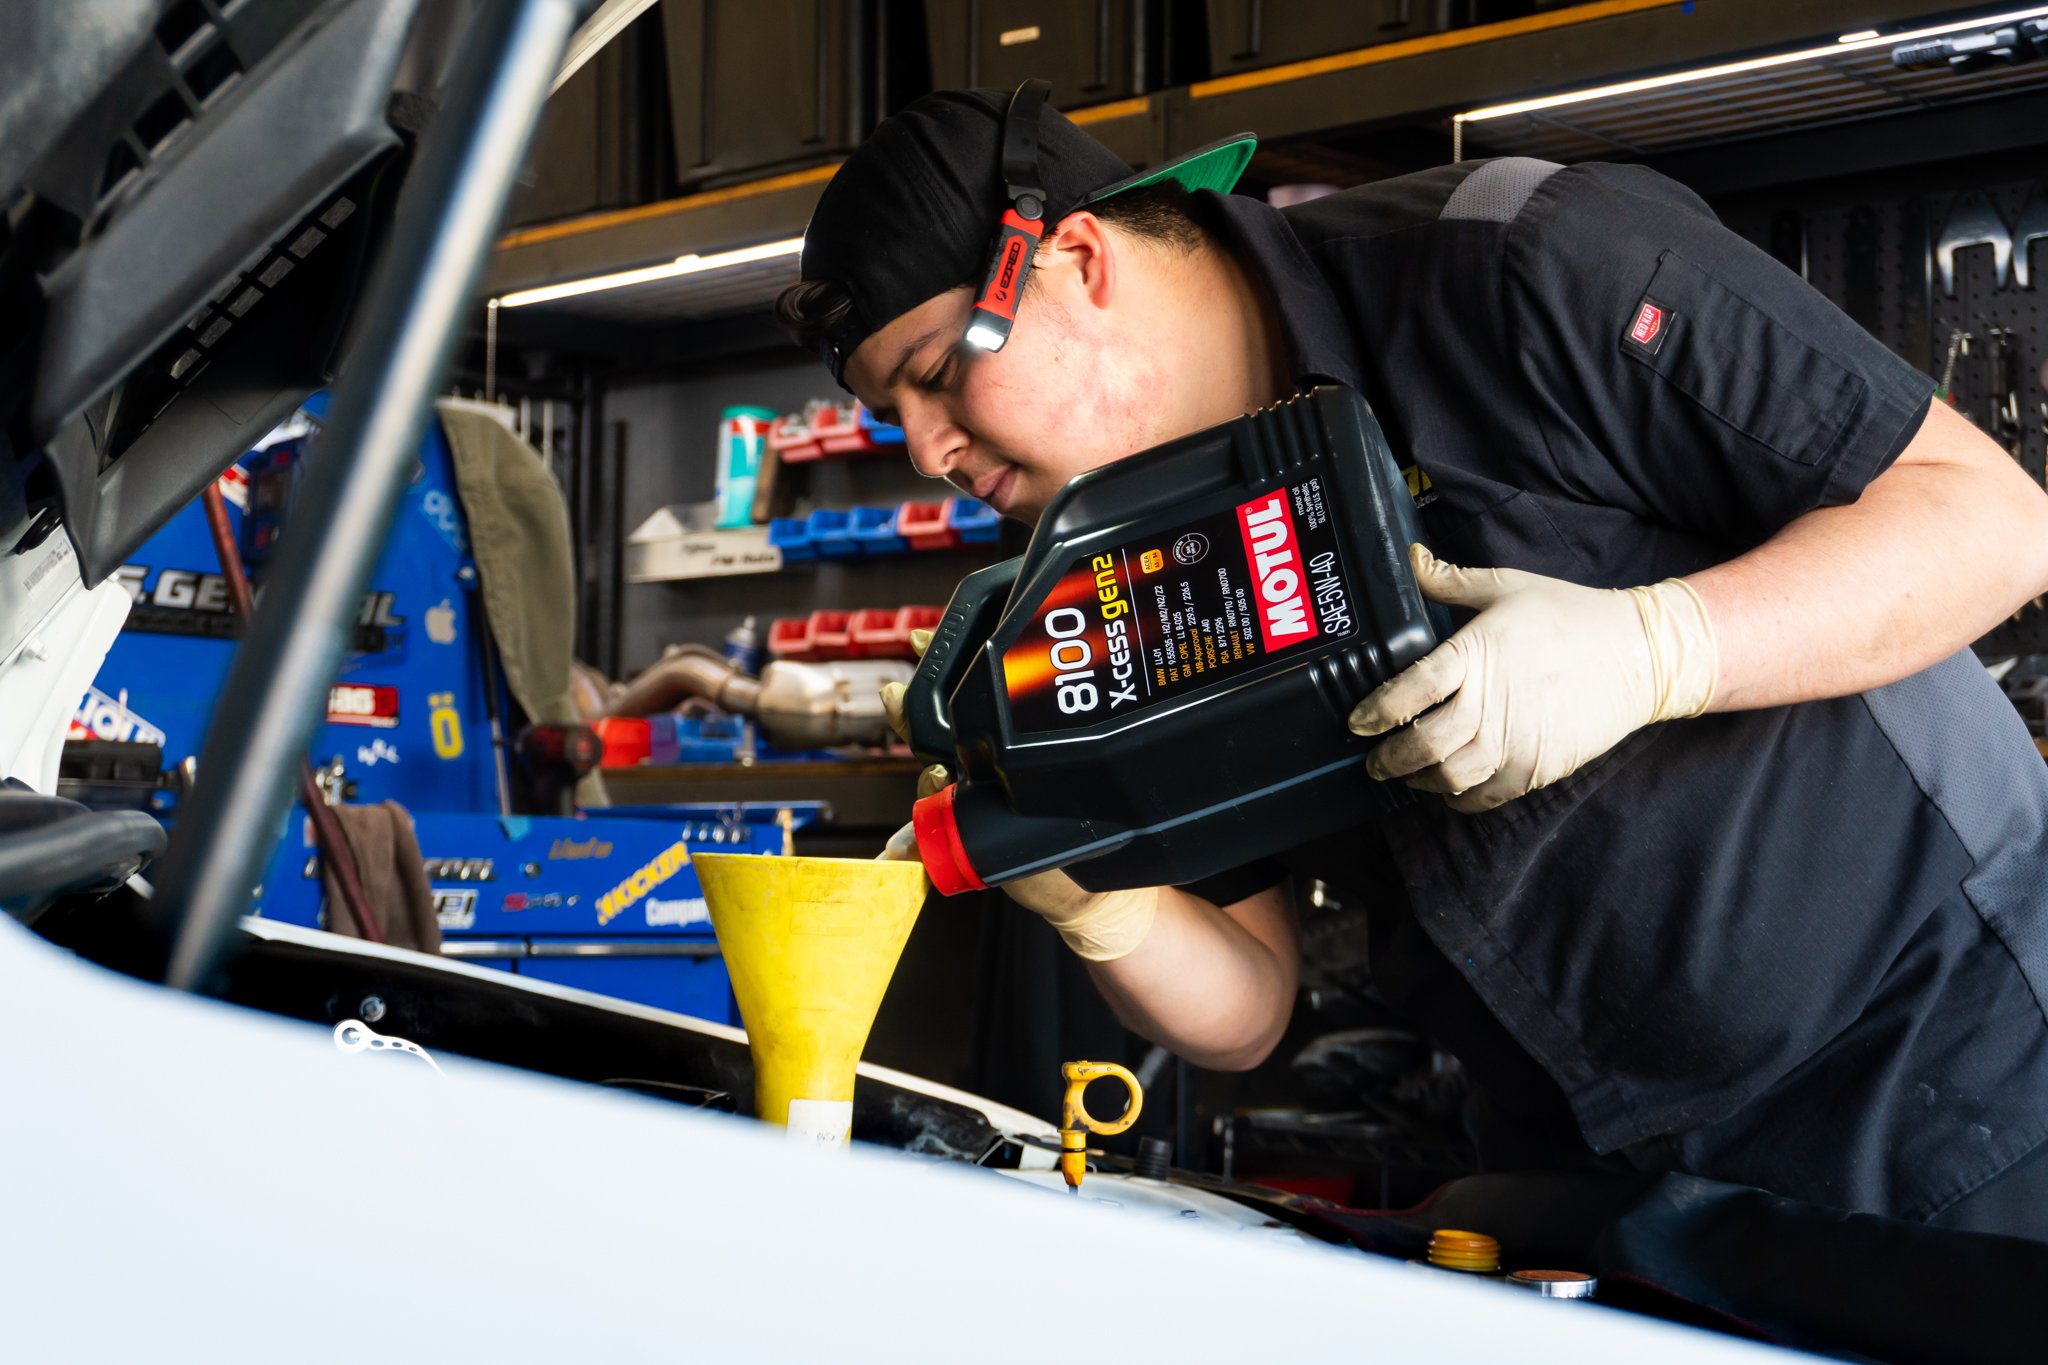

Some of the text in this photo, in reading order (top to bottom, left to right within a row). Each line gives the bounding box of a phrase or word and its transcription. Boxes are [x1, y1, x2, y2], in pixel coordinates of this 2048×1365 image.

[1001, 242, 1021, 289] EZRED
[1635, 322, 1649, 338] RED
[1640, 308, 1655, 325] KAP
[1292, 487, 1304, 516] motor oil
[1301, 481, 1314, 512] Synthetic
[1246, 499, 1309, 636] MOTUL
[1311, 552, 1344, 605] 5W-40
[1180, 581, 1192, 601] 226.5
[1218, 568, 1230, 595] RN0700
[1235, 588, 1245, 598] 00
[1185, 607, 1196, 626] 229.5
[1224, 600, 1237, 627] RN0710
[1237, 598, 1247, 611] 505
[1320, 599, 1351, 634] SAE
[1092, 554, 1137, 709] X-cess gen2
[1173, 611, 1184, 631] B-025
[1241, 617, 1250, 627] 00
[1243, 627, 1253, 640] 502
[920, 602, 973, 682] MOTUL
[1177, 631, 1185, 639] LL
[1201, 619, 1216, 668] PORSCHE A40
[1214, 617, 1229, 664] PSA B71 2296
[1230, 630, 1242, 659] RENAULT
[1045, 608, 1098, 714] 8100
[1164, 638, 1176, 665] 9.55535
[1179, 642, 1189, 659] OPEL
[1190, 628, 1204, 673] MB-Approval
[1246, 643, 1255, 655] VW
[1153, 648, 1166, 686] BMW LL-01
[1169, 668, 1179, 682] FIAT
[1182, 664, 1192, 677] GM
